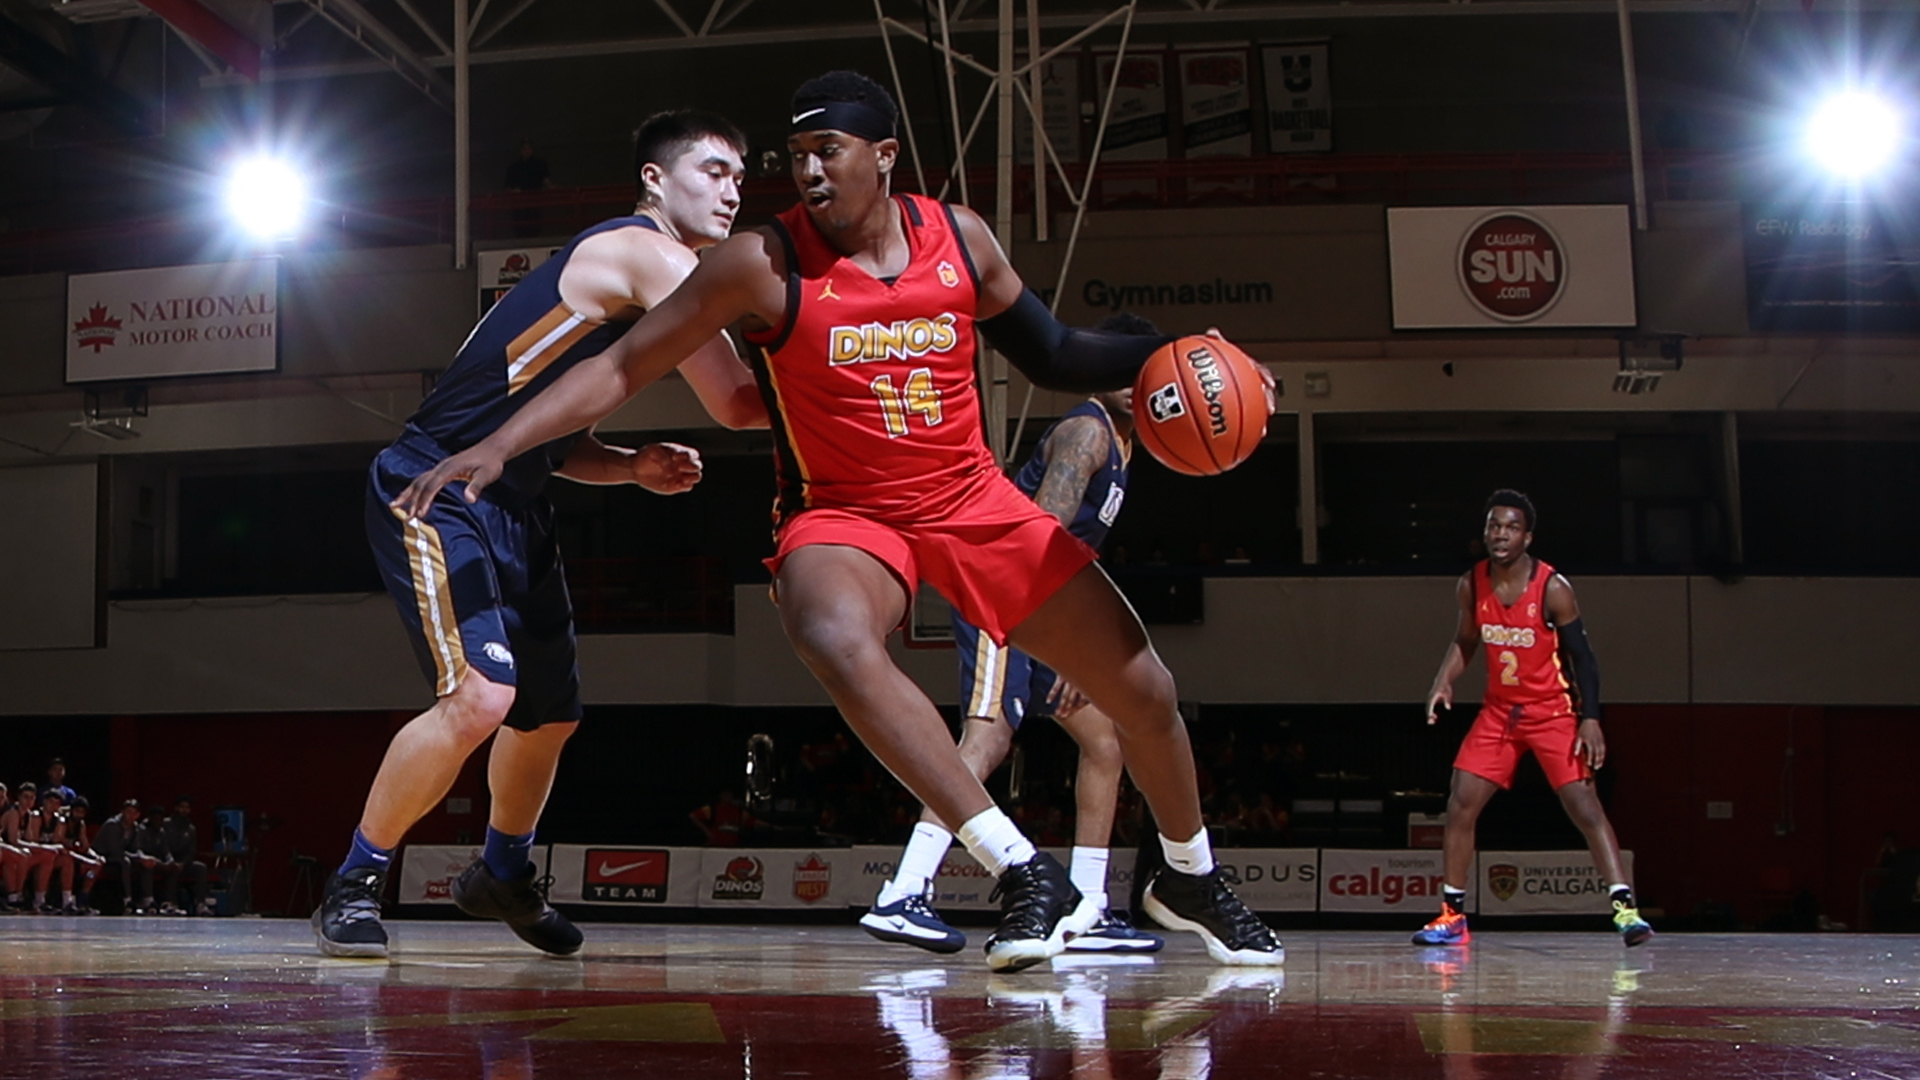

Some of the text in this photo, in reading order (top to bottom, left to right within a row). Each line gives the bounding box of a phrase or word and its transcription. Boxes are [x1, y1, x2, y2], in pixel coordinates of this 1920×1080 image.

[1485, 233, 1536, 246] CALGARY
[1470, 250, 1556, 284] SUN
[1083, 278, 1274, 311] Gymnasium
[1496, 286, 1531, 299] .com
[129, 293, 276, 324] NATIONAL
[129, 323, 273, 347] MOTOR COACH
[829, 312, 957, 366] DINOS
[871, 367, 942, 439] 14
[1187, 347, 1227, 438] Wilson
[1481, 624, 1535, 648] DINOS
[1499, 650, 1520, 686] 2
[1388, 859, 1436, 869] tourism
[1524, 866, 1601, 876] UNIVERSIT
[594, 886, 657, 898] TEAM
[715, 880, 763, 894] DINOS
[797, 881, 826, 896] WEST
[1328, 867, 1445, 904] calgar
[1523, 878, 1610, 895] CALGAR
